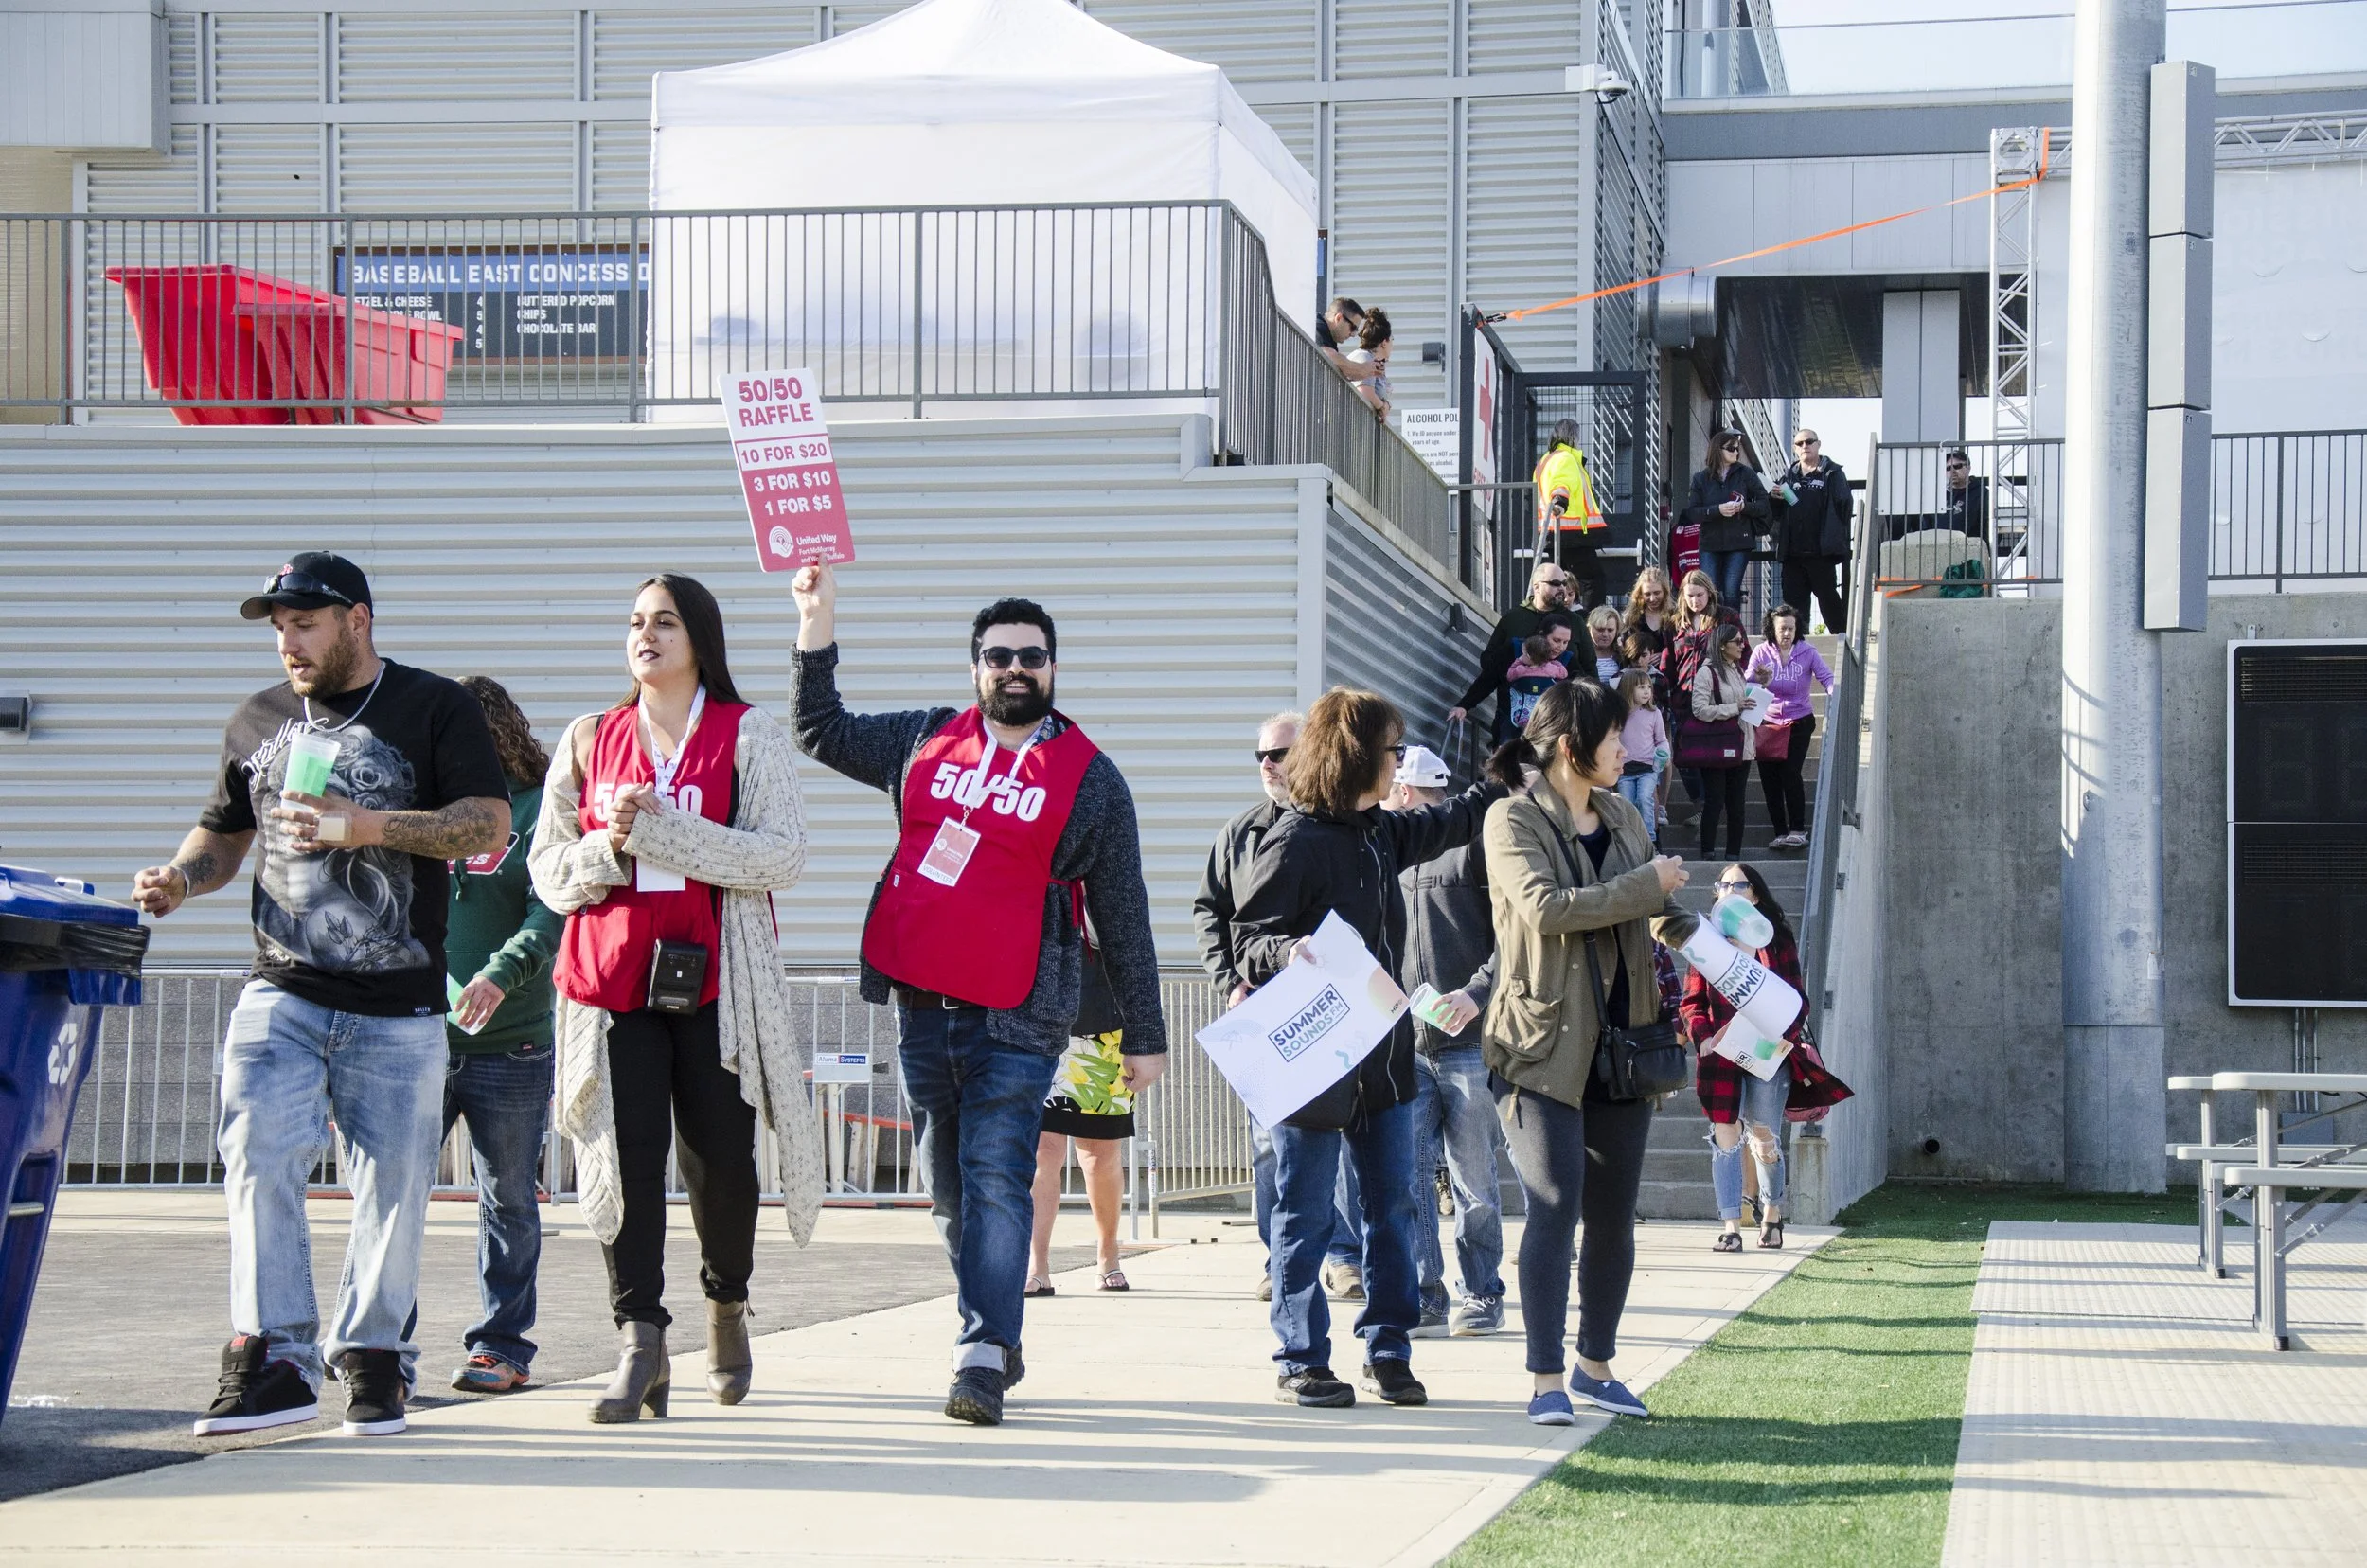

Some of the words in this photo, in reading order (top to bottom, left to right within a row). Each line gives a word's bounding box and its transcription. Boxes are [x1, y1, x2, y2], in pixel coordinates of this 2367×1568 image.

[354, 265, 460, 283] BASEBALL
[469, 264, 521, 283] EAST
[529, 262, 650, 282] CONCESSO
[346, 296, 383, 307] ETZEL
[395, 296, 433, 307] CHEESE
[476, 296, 483, 307] 4
[570, 295, 614, 306] POPCORN
[476, 310, 483, 320] 5
[475, 325, 483, 334] 4
[475, 338, 483, 348] 5
[739, 377, 802, 402] 50/50
[739, 403, 813, 427] RAFFLE
[1407, 414, 1442, 423] ALCOHOL
[741, 449, 759, 463] 10
[764, 445, 794, 462] FOR
[799, 443, 827, 459] $20
[754, 477, 764, 491] 3
[768, 473, 799, 490] FOR
[803, 471, 830, 489] $10
[765, 501, 773, 515] 1
[777, 498, 810, 514] FOR
[812, 495, 831, 512] $5
[796, 534, 820, 545] United
[820, 533, 836, 543] Way
[930, 761, 1047, 822] 50/50
[1274, 990, 1338, 1046] SUMMER
[1283, 1013, 1333, 1057] SOUNDS
[1330, 1001, 1344, 1015] FM
